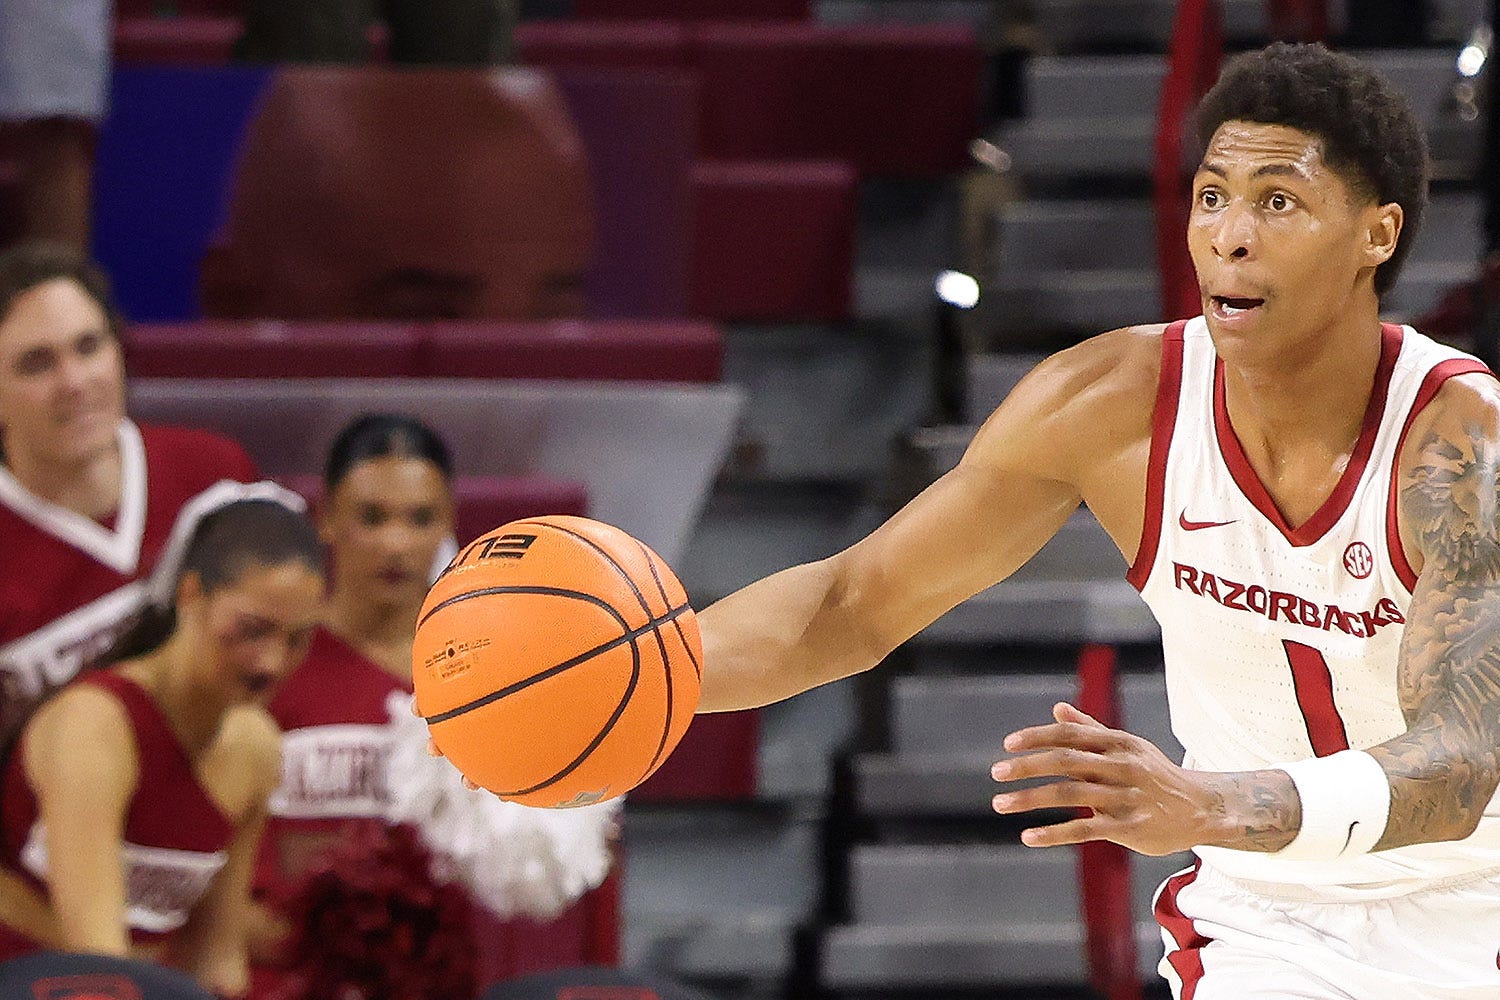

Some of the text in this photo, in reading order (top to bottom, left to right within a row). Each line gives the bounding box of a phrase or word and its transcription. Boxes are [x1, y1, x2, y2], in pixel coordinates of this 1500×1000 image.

[1345, 544, 1373, 577] SEC
[1172, 561, 1406, 639] RAZORBACKS
[1281, 638, 1350, 759] 1
